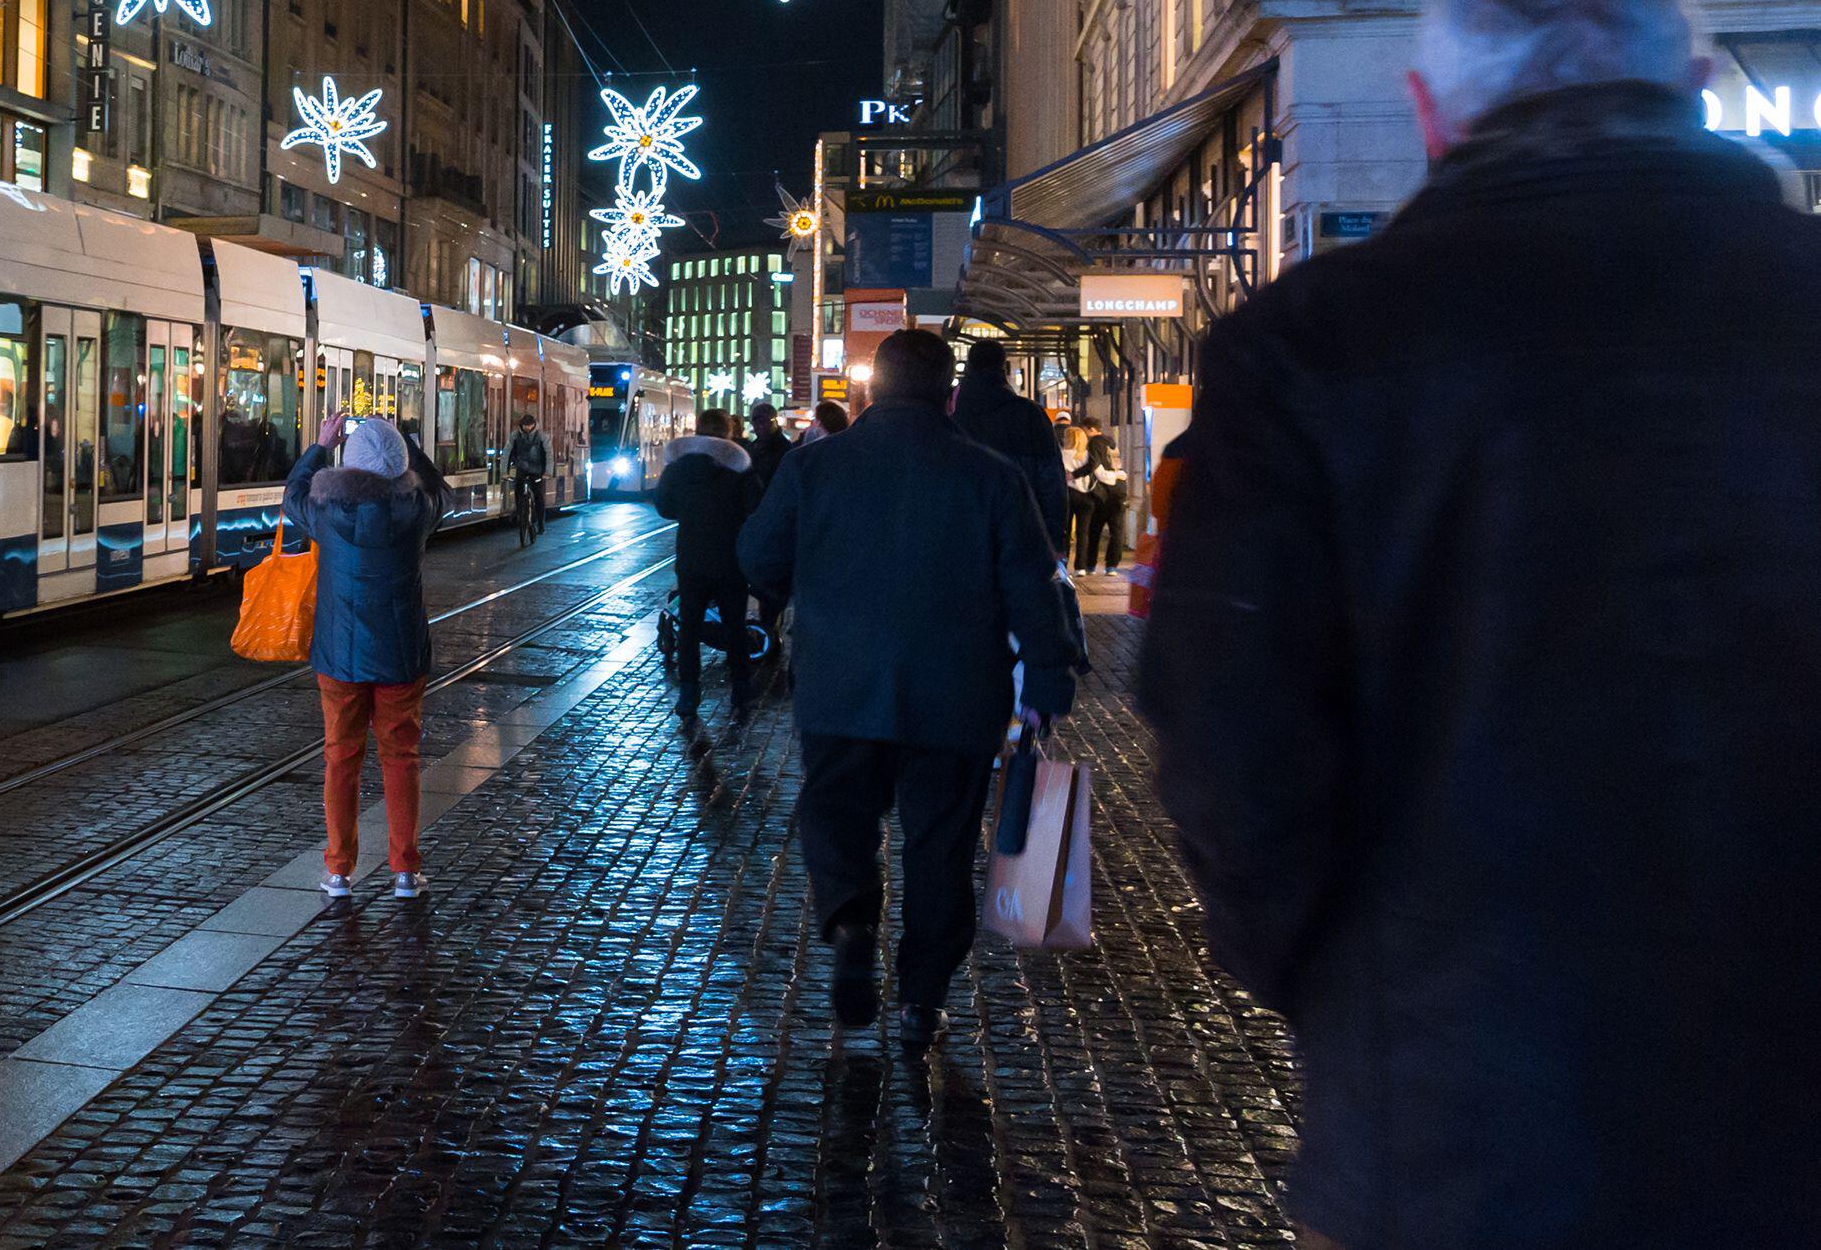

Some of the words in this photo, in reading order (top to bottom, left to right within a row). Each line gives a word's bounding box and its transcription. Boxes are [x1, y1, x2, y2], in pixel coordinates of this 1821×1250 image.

[859, 99, 923, 124] PK
[543, 124, 553, 184] FRASER
[542, 188, 551, 248] SUITES
[1086, 300, 1178, 311] LONGCHAMP
